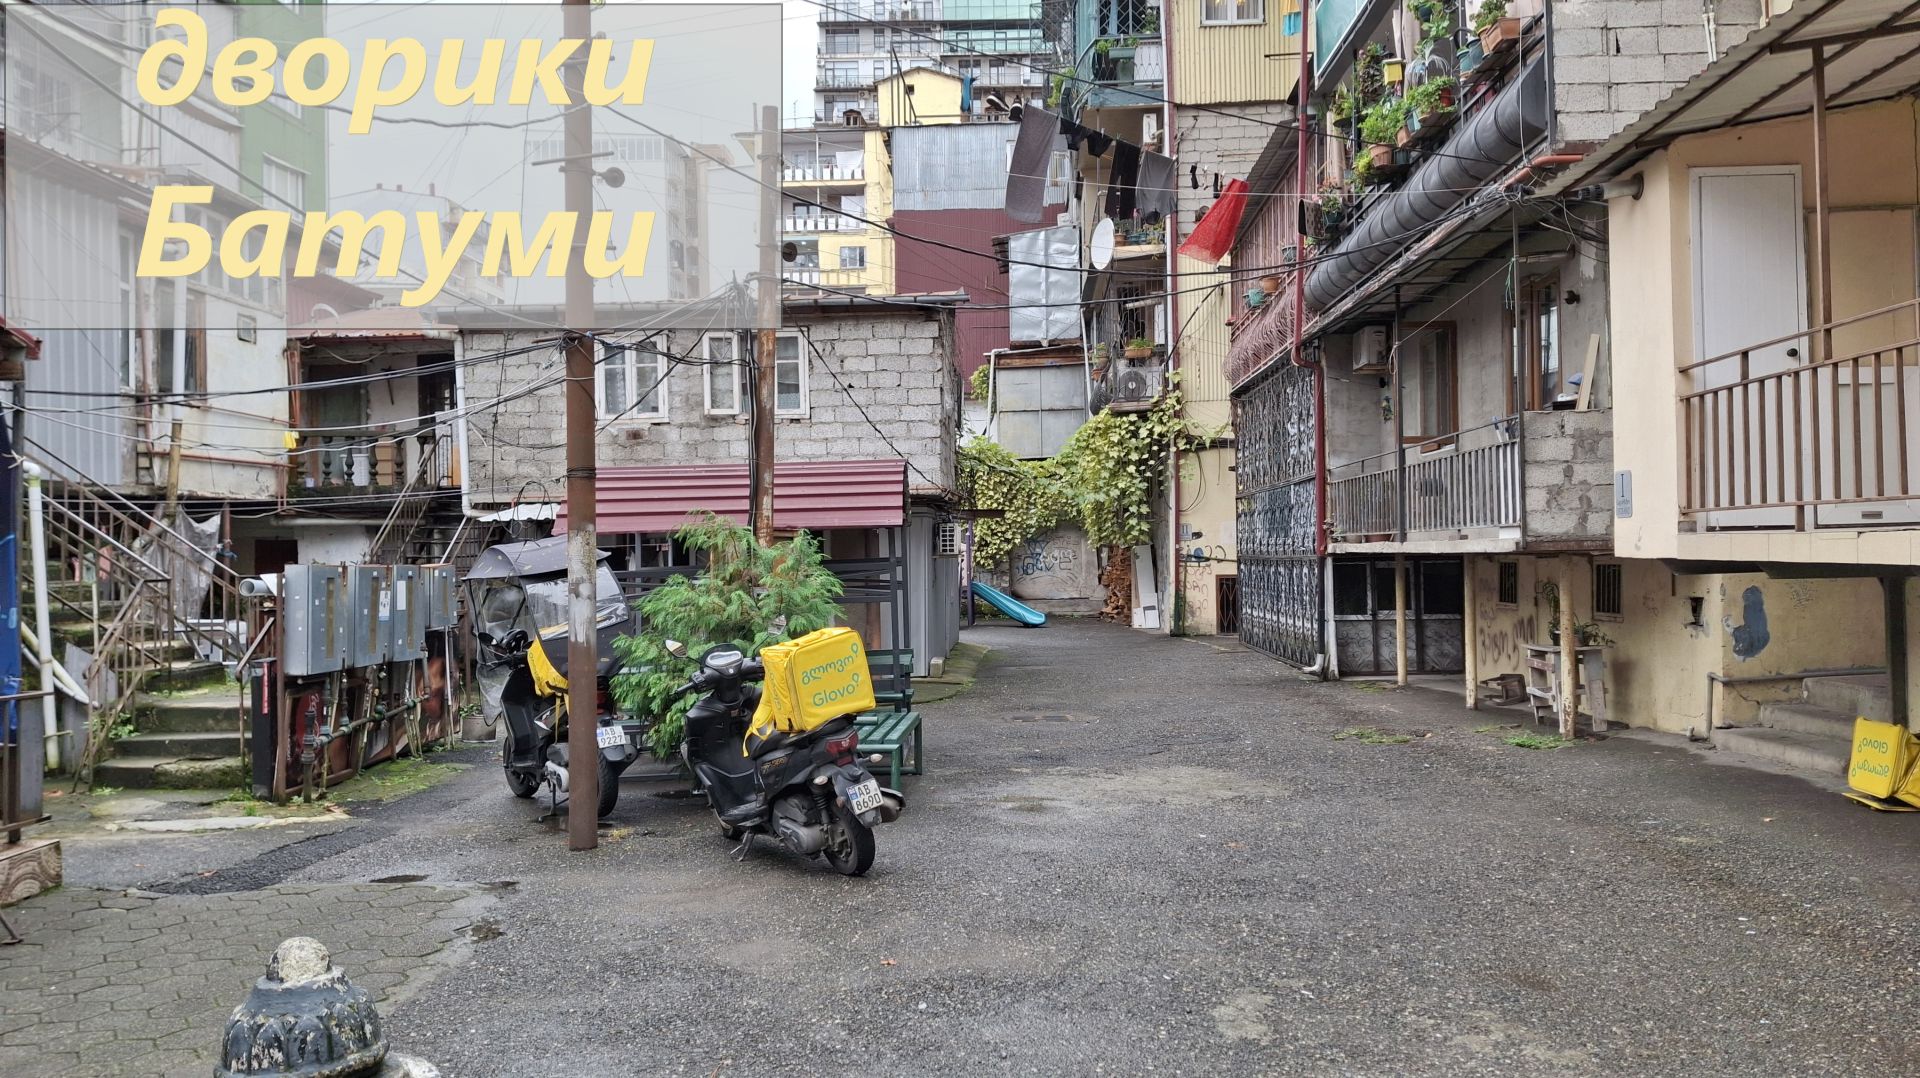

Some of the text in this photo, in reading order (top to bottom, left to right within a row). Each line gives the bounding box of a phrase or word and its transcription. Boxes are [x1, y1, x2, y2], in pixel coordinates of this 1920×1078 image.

[812, 682, 856, 707] Glovo
[605, 728, 616, 736] AB
[601, 735, 623, 746] 9227
[1861, 737, 1888, 754] Glovo
[857, 784, 871, 797] AB
[855, 793, 882, 811] 8690
